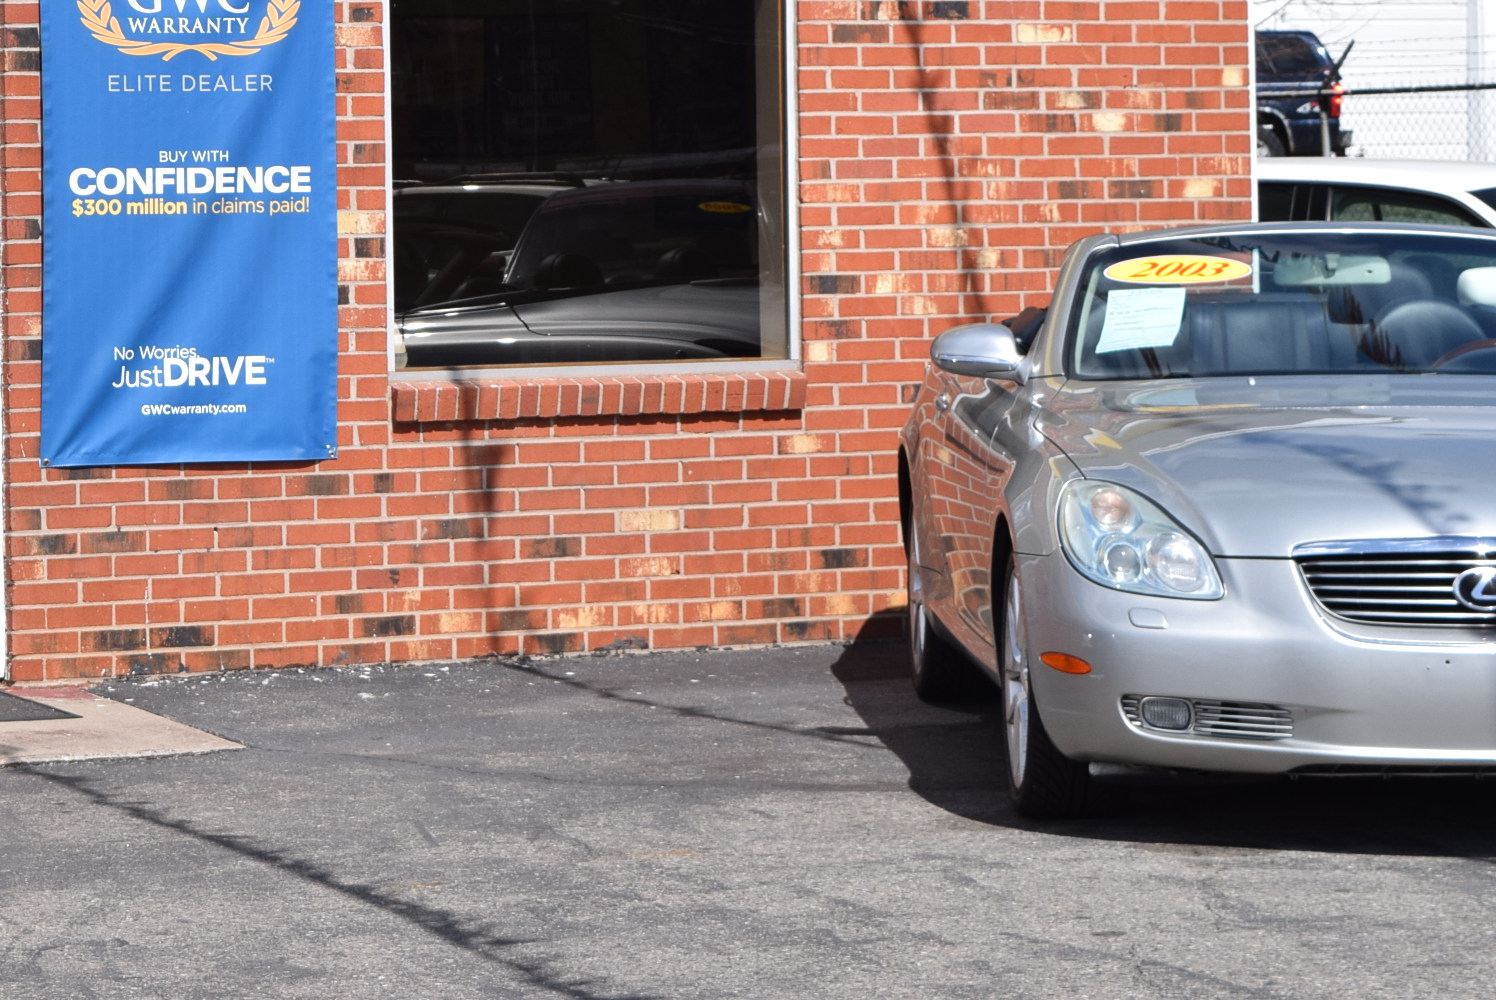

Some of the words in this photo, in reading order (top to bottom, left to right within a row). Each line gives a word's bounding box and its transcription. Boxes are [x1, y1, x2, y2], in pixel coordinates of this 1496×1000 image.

[127, 17, 250, 34] WARRANTY
[108, 74, 172, 92] ELITE
[181, 74, 273, 92] DEALER
[159, 150, 188, 163] BUY
[192, 150, 229, 163] WITH
[69, 165, 312, 196] CONFIDENCE
[72, 198, 122, 217] $300
[126, 198, 188, 215] million
[192, 198, 207, 214] in
[211, 197, 265, 214] claims
[269, 196, 310, 216] paid!
[1128, 261, 1230, 278] 2003
[114, 346, 134, 361] No
[141, 403, 247, 416] GWCwarranty.com
